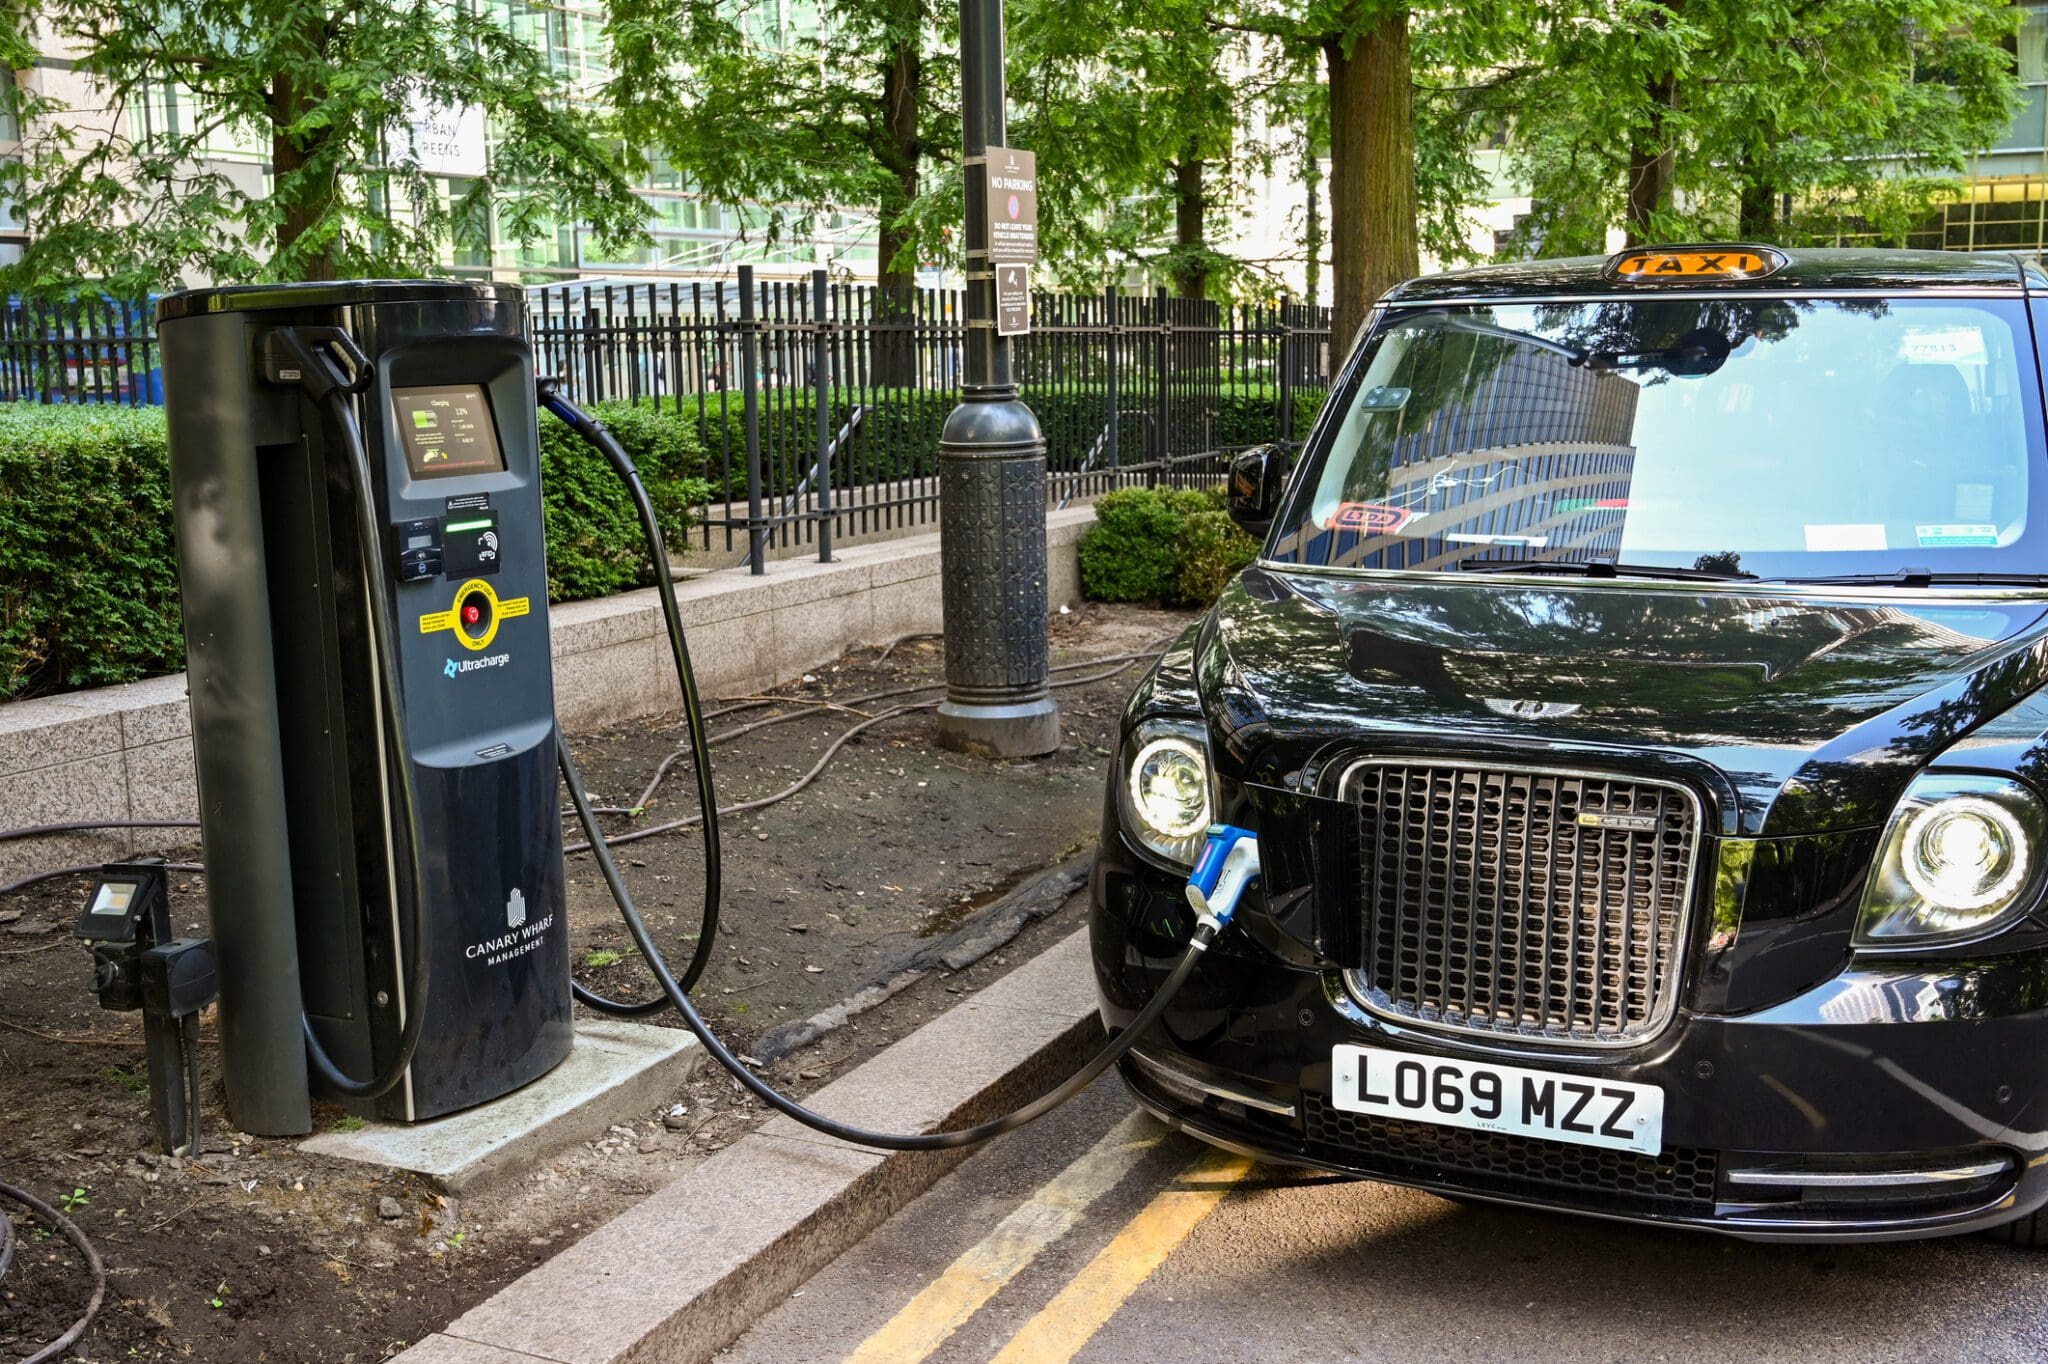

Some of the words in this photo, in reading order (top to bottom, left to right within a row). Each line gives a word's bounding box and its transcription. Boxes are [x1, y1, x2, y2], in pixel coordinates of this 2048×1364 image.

[423, 122, 457, 136] RBAN
[422, 142, 461, 158] REENS
[991, 176, 1003, 190] NO
[1003, 177, 1034, 192] PARKING
[1632, 255, 1748, 273] TAXI
[457, 583, 484, 604] EMERGENCY
[471, 639, 485, 648] ONLY
[458, 653, 510, 673] Ultracharge
[465, 931, 519, 959] CANARY
[521, 913, 554, 940] WHARF
[487, 935, 545, 967] MANAGEMENT
[1357, 1054, 1503, 1121] LO69
[1520, 1075, 1636, 1141] MZZ
